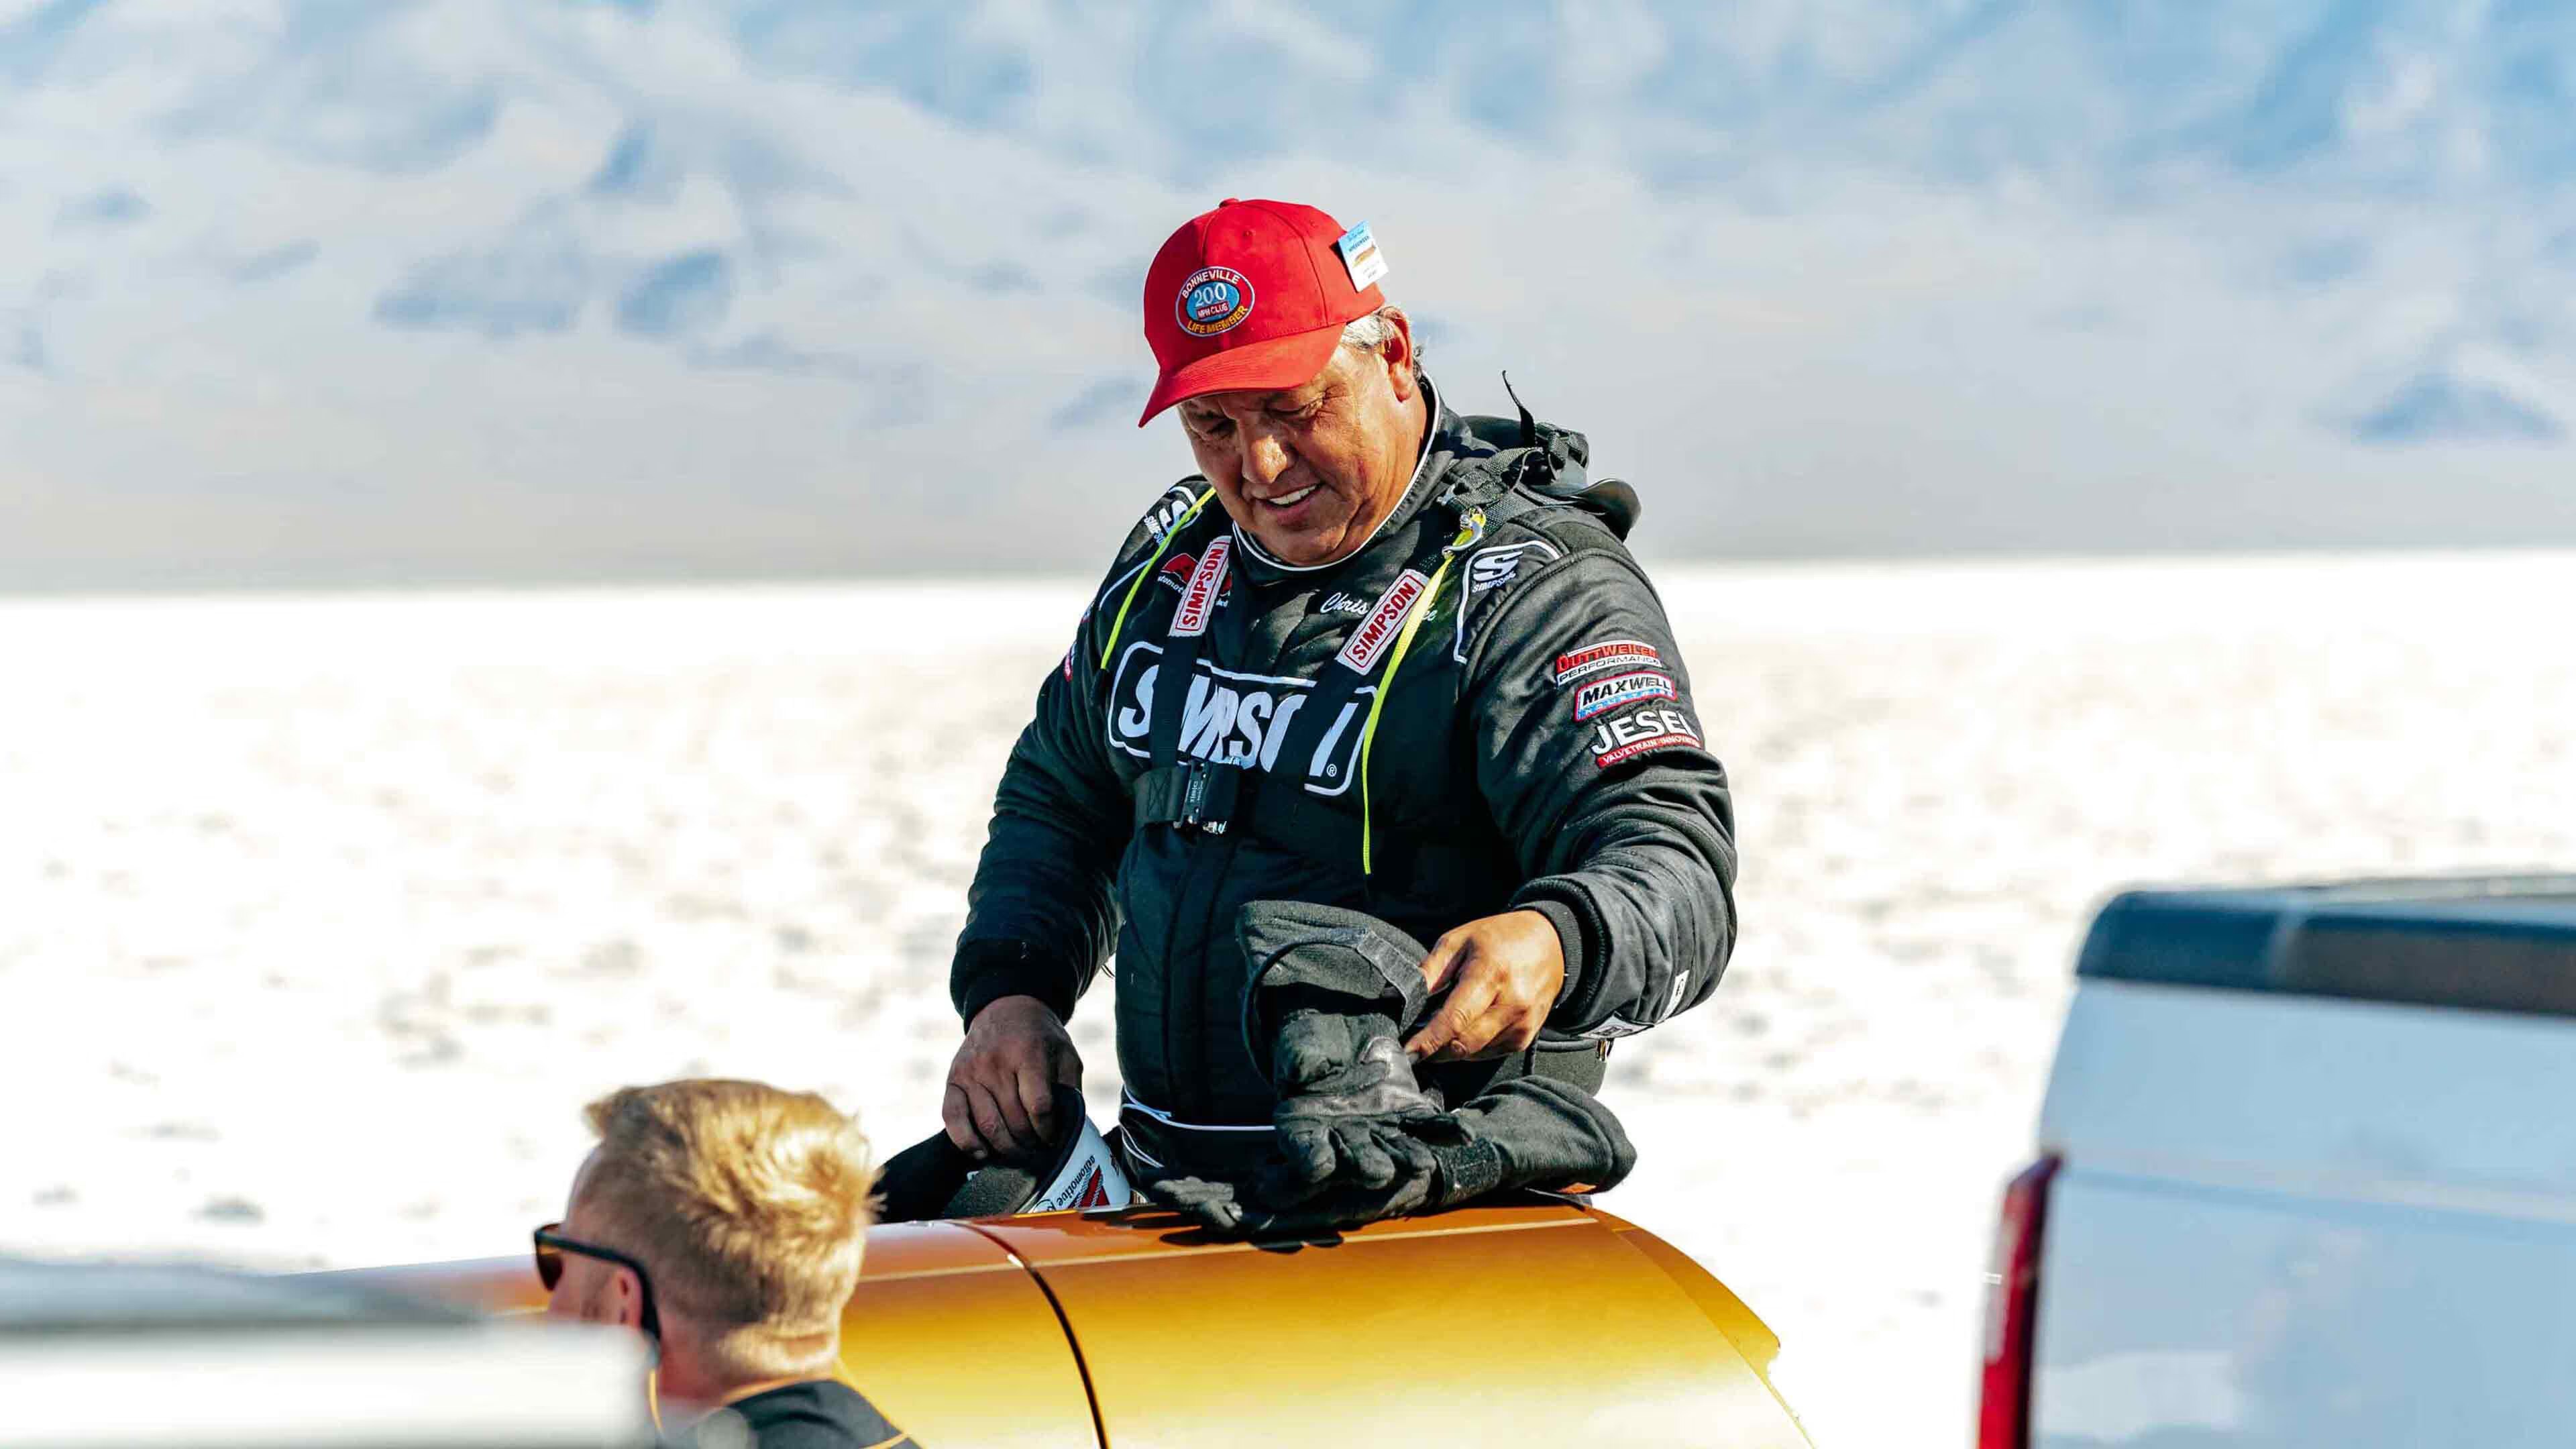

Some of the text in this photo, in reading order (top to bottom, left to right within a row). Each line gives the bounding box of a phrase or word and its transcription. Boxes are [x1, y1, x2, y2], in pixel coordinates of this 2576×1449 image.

[1182, 269, 1240, 299] BONNEVILLE
[1193, 282, 1227, 308] 200
[1187, 321, 1205, 334] LIFE
[1182, 548, 1224, 627] SIMPSON
[1320, 592, 1368, 615] Chris
[1352, 582, 1417, 661] SIMPSON
[1582, 676, 1670, 706] MAXWELL
[1056, 1155, 1095, 1206] automotive
